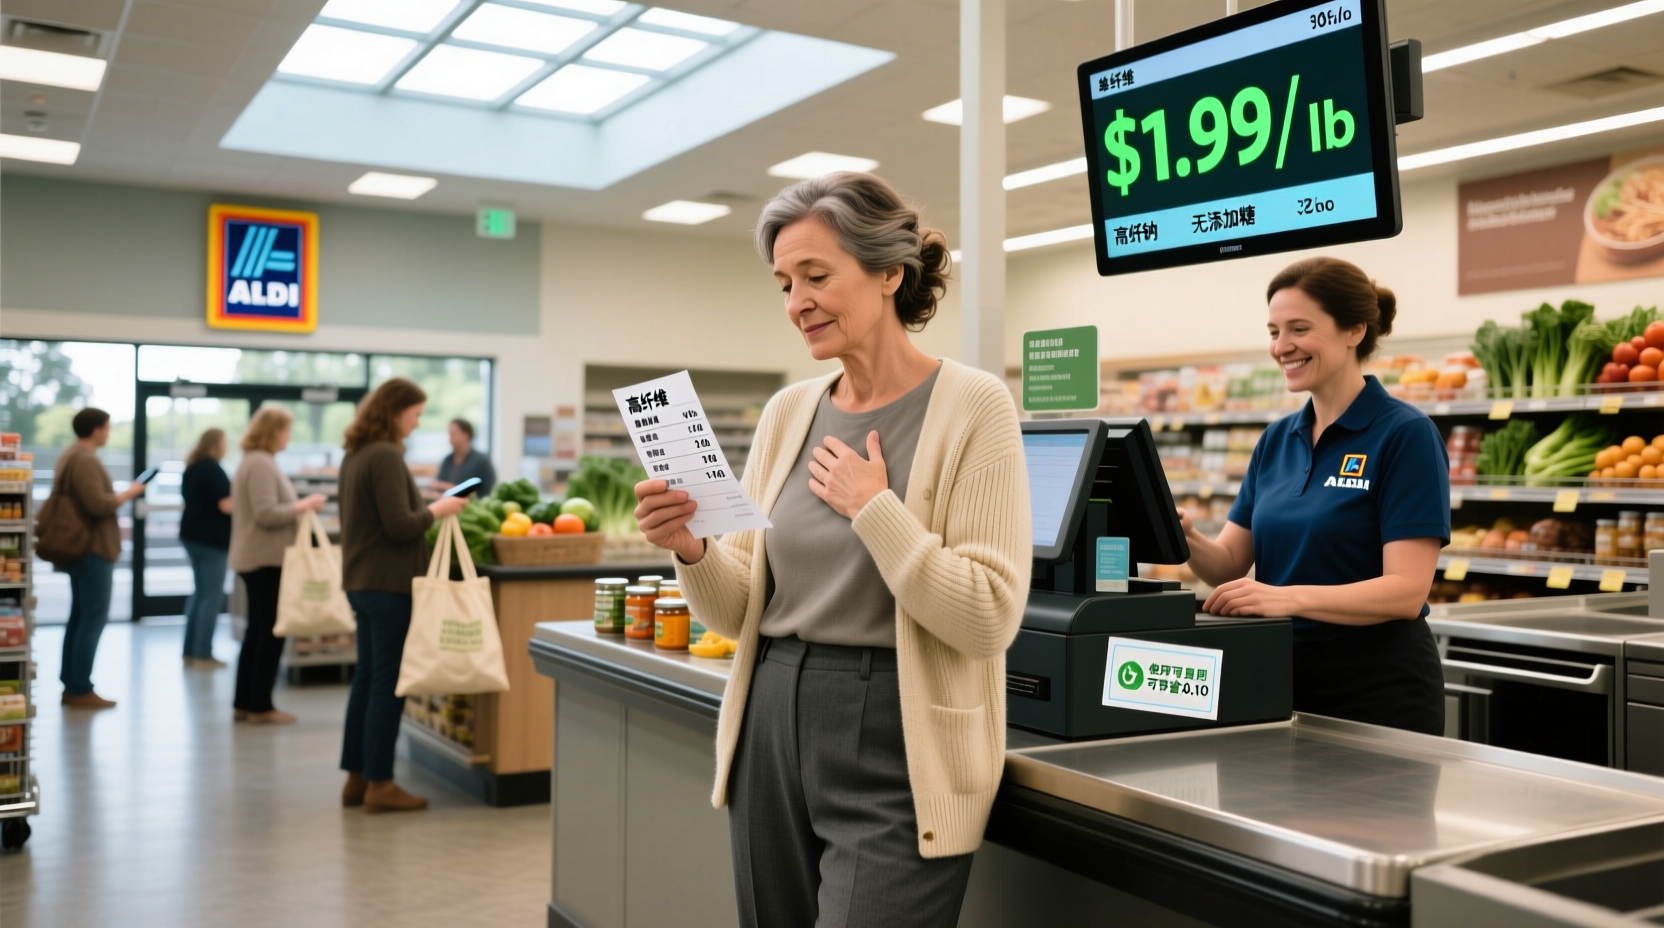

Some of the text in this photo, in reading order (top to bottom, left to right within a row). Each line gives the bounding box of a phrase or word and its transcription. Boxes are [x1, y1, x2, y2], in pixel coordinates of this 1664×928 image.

[1191, 204, 1256, 234] 无添加糖
[227, 279, 299, 308] ALDI
[625, 388, 670, 416] 高纤维
